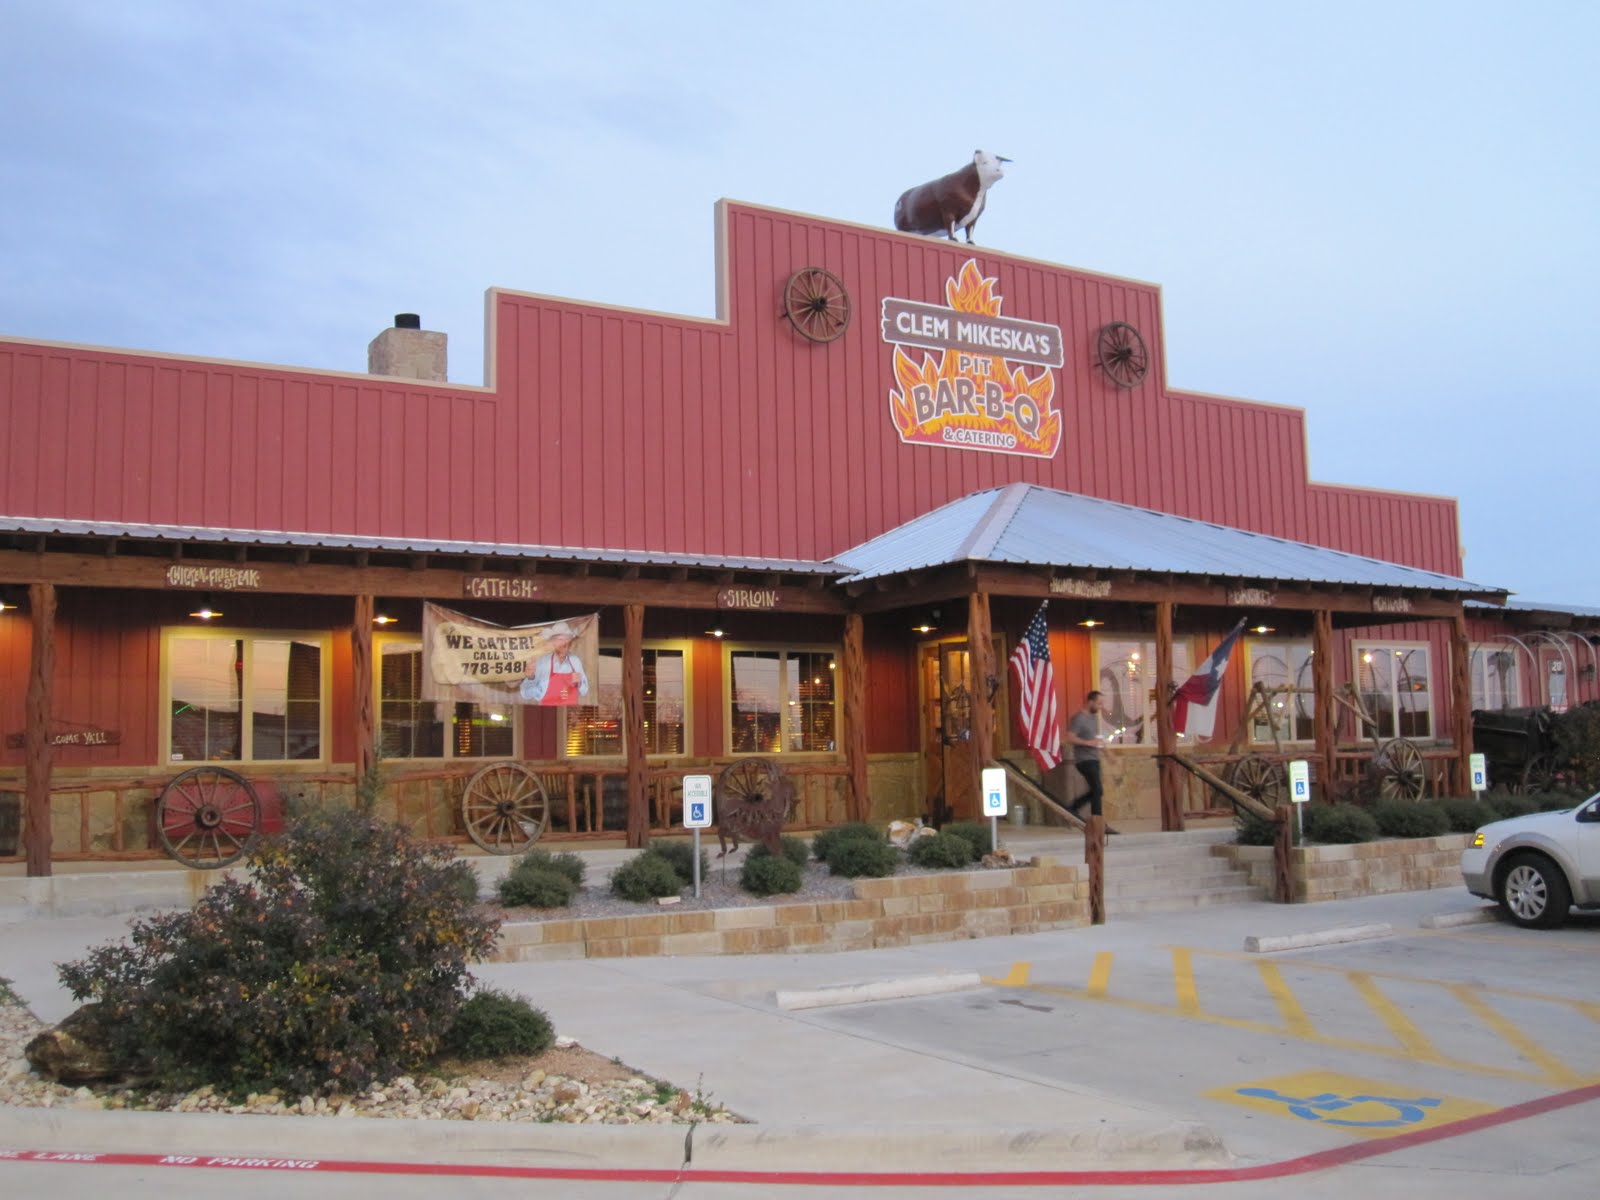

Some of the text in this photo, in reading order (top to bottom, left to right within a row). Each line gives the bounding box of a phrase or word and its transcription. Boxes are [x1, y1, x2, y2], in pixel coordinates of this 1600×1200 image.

[896, 312, 1050, 355] CLEM MIKESKA'S
[959, 355, 992, 375] PIT
[913, 378, 1039, 439] BAR-B-Q
[169, 565, 207, 587] CHICKEN
[209, 567, 236, 587] FRIED
[472, 577, 532, 598] CATFISH
[727, 589, 775, 608] SIRLOIN
[446, 634, 534, 651] WE CATER!
[473, 651, 515, 661] CALL US
[160, 1155, 199, 1164] NO
[206, 1157, 320, 1168] PARKING
